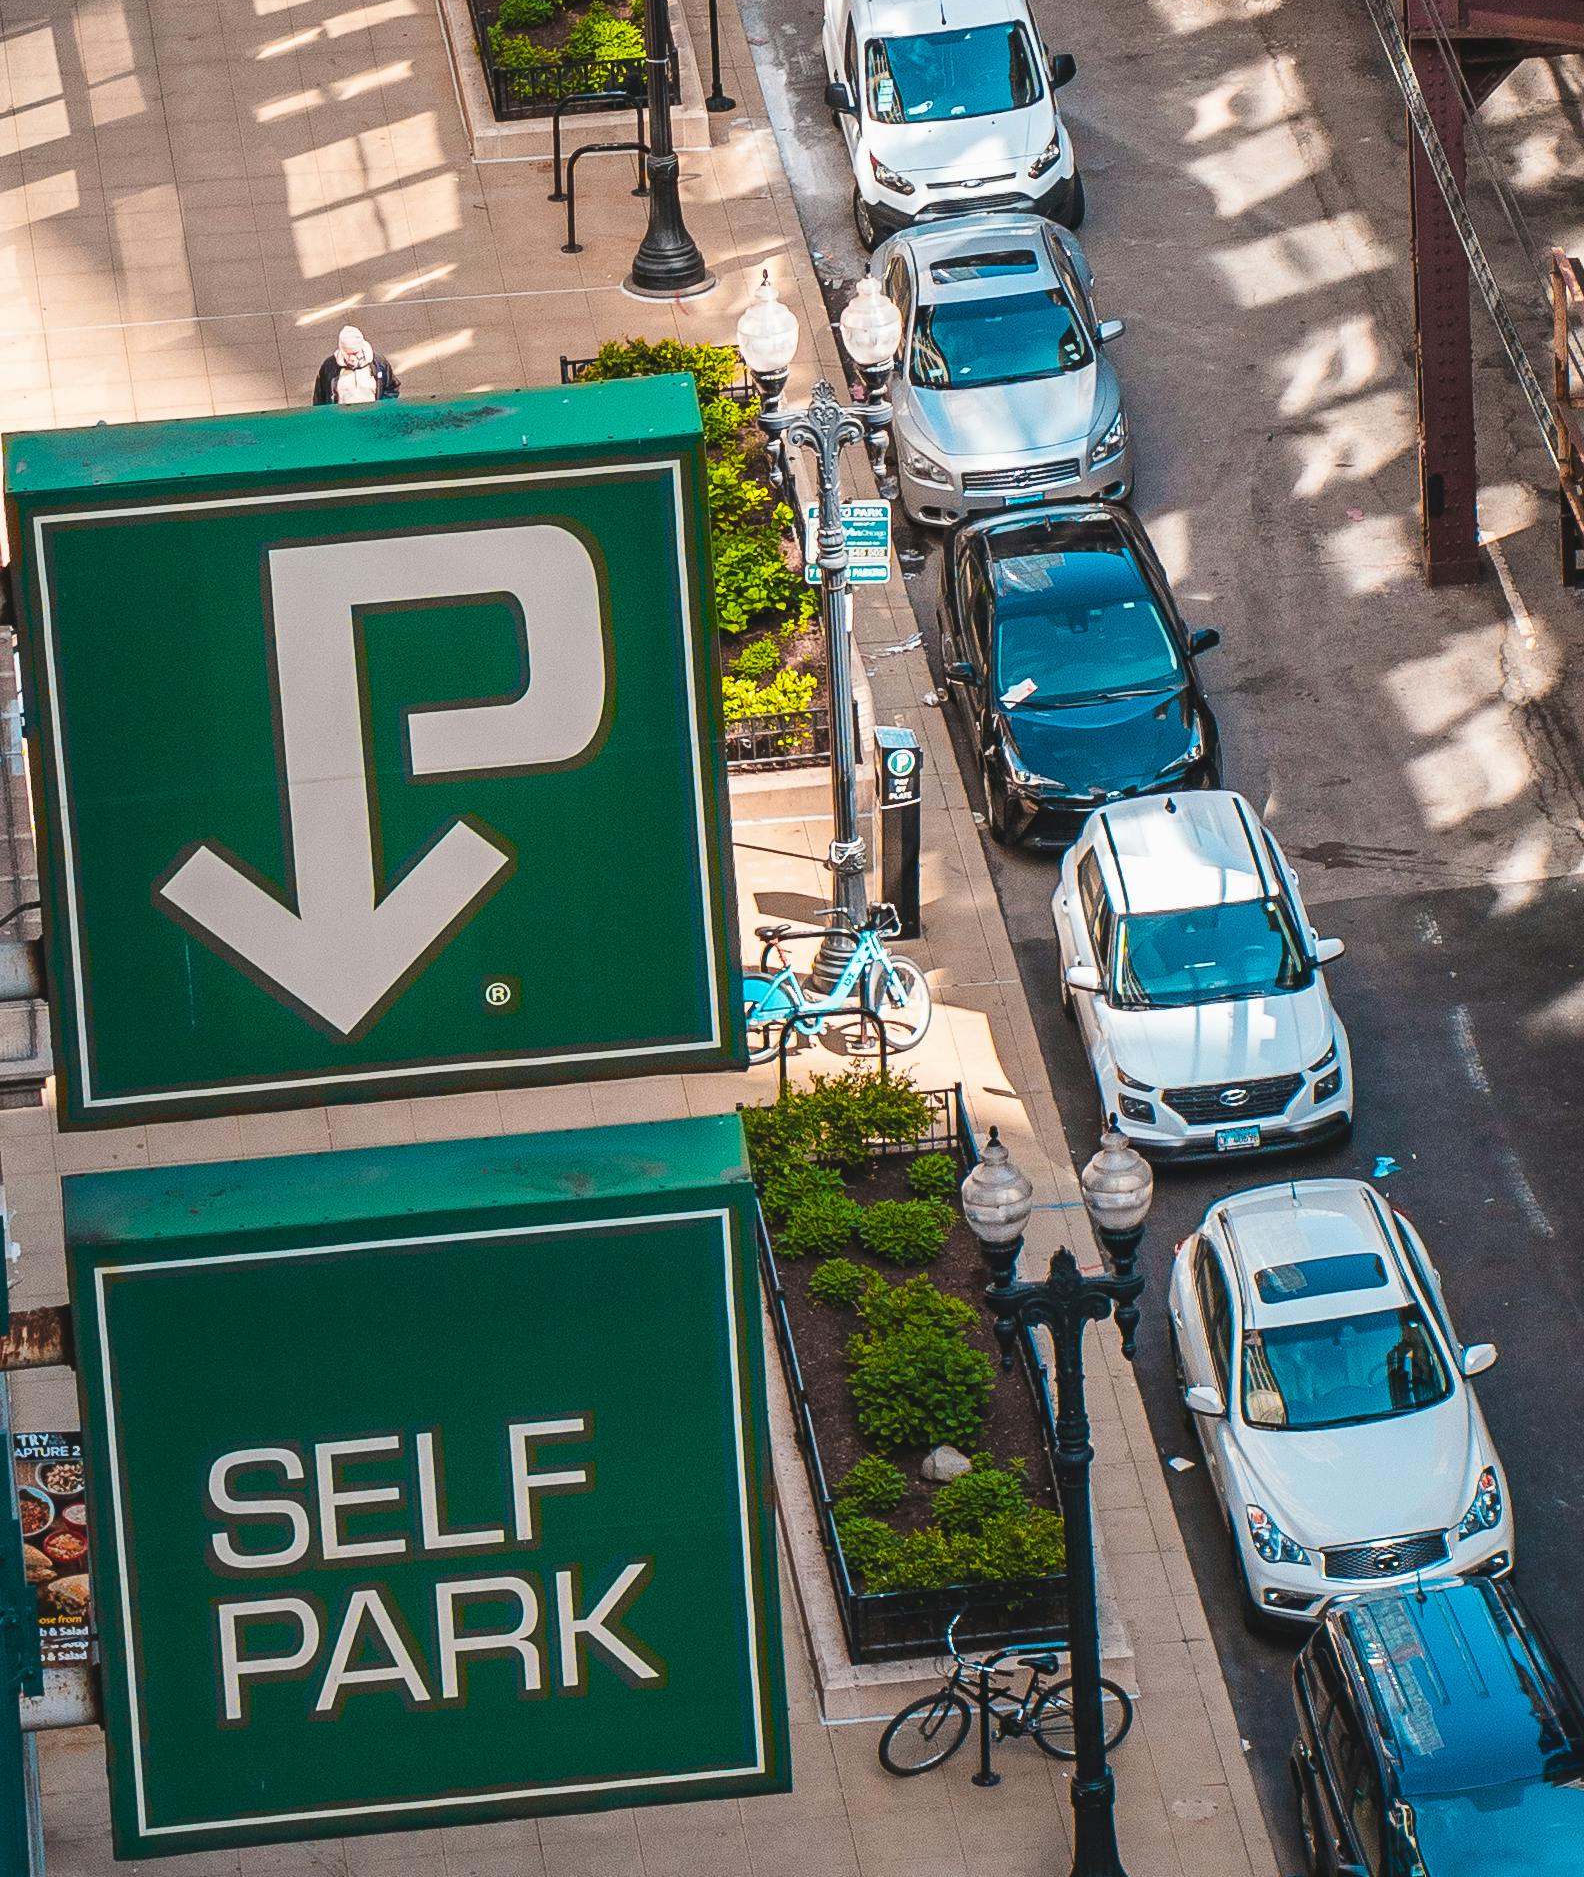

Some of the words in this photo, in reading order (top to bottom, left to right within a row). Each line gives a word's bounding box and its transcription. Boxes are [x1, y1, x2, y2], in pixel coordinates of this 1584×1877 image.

[853, 508, 884, 517] PARK
[17, 1433, 50, 1446] TRY
[15, 1446, 69, 1458] APTURE
[72, 1445, 82, 1457] 2
[208, 1417, 587, 1570] SELF
[58, 1616, 82, 1624] from
[60, 1625, 89, 1636] Salad
[218, 1562, 661, 1721] PARK
[58, 1650, 88, 1661] Salad
